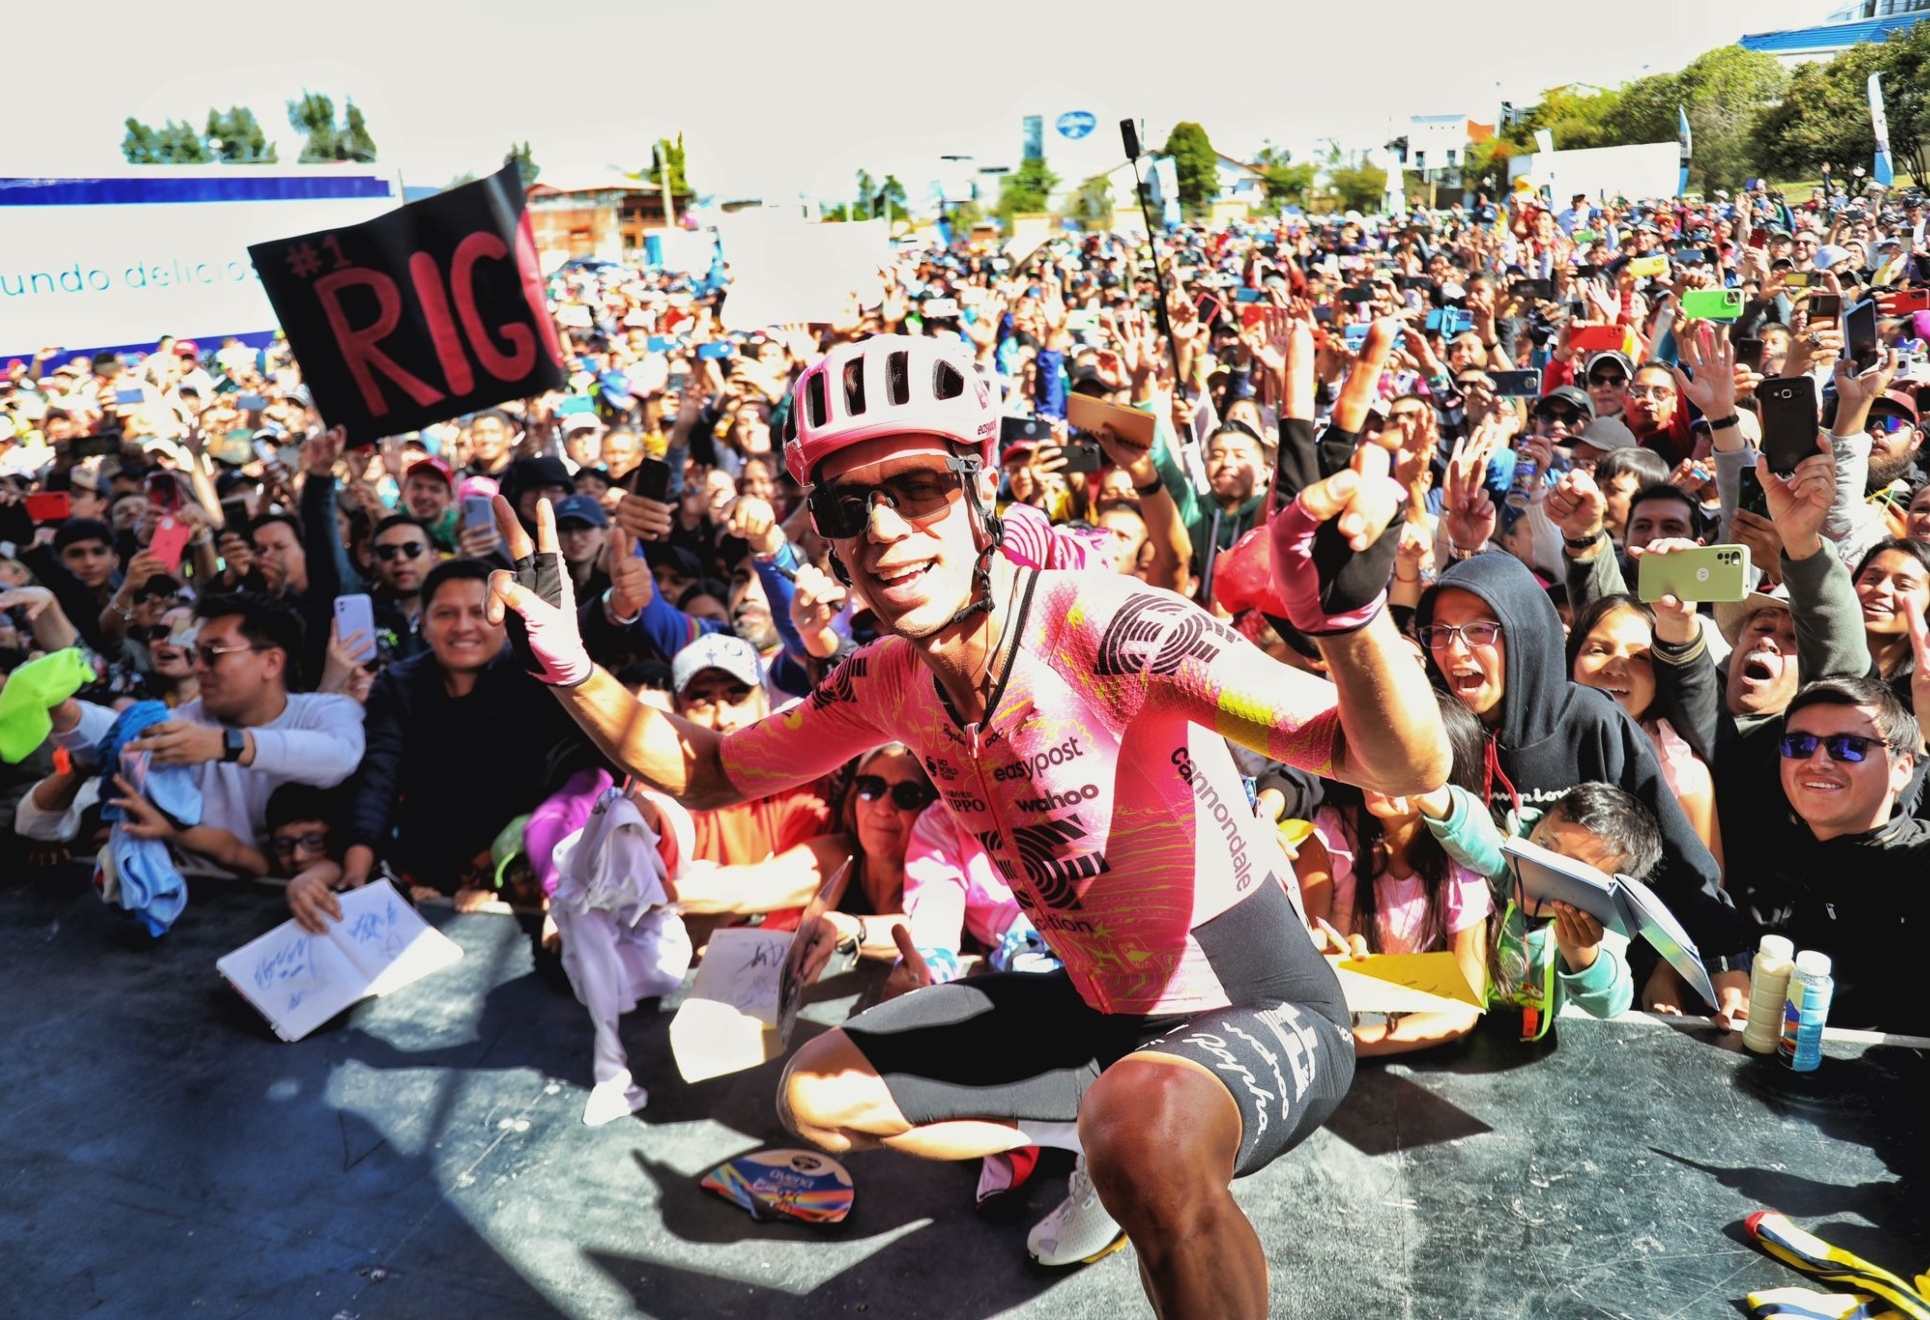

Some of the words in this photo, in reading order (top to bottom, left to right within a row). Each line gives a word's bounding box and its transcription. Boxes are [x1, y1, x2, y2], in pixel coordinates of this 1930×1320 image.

[285, 234, 352, 278] #1
[994, 736, 1084, 782] easypost
[949, 799, 986, 813] IPPO
[1015, 784, 1099, 812] wahoo
[1171, 747, 1252, 892] cannondale
